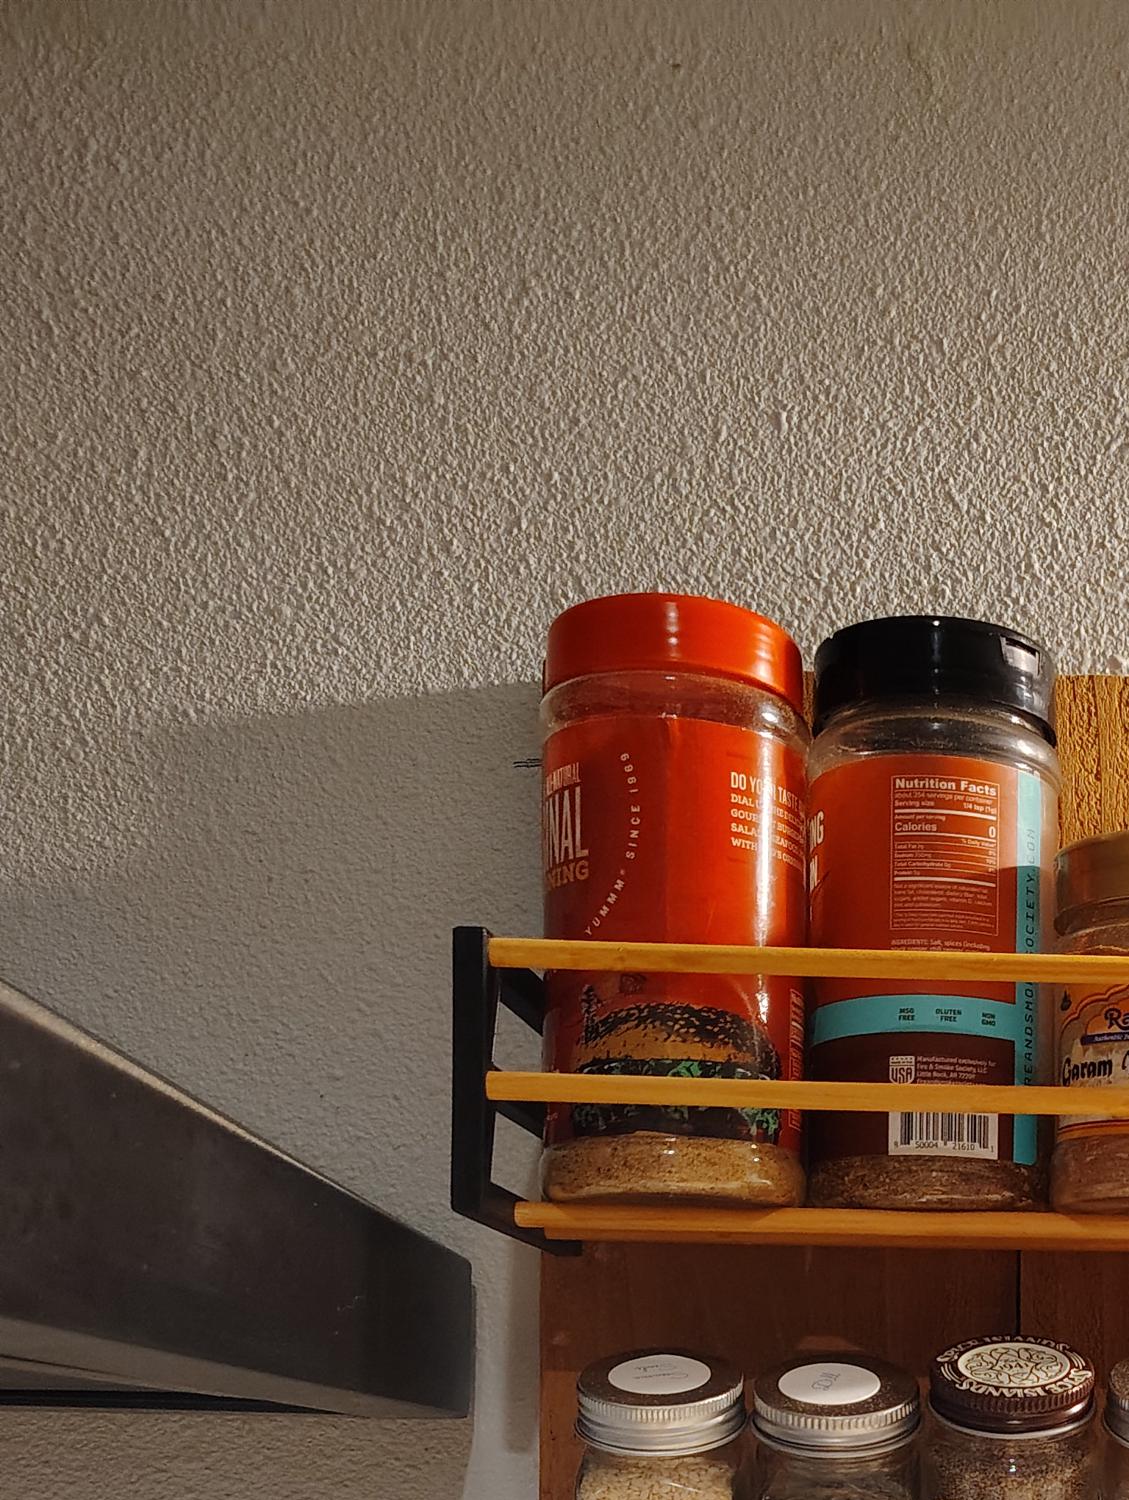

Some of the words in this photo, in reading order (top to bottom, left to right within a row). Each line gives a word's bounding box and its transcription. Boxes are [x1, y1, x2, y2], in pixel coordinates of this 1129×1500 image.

[731, 772, 746, 790] DO
[895, 779, 956, 790] Nutrition
[960, 781, 996, 796] Facts
[731, 794, 754, 807] DIAL
[625, 805, 640, 859] SINCE
[895, 822, 937, 832] Calories
[989, 826, 996, 838] 0
[731, 837, 757, 851] WITH
[891, 1067, 912, 1083] USA
[1062, 1056, 1113, 1087] Garam
